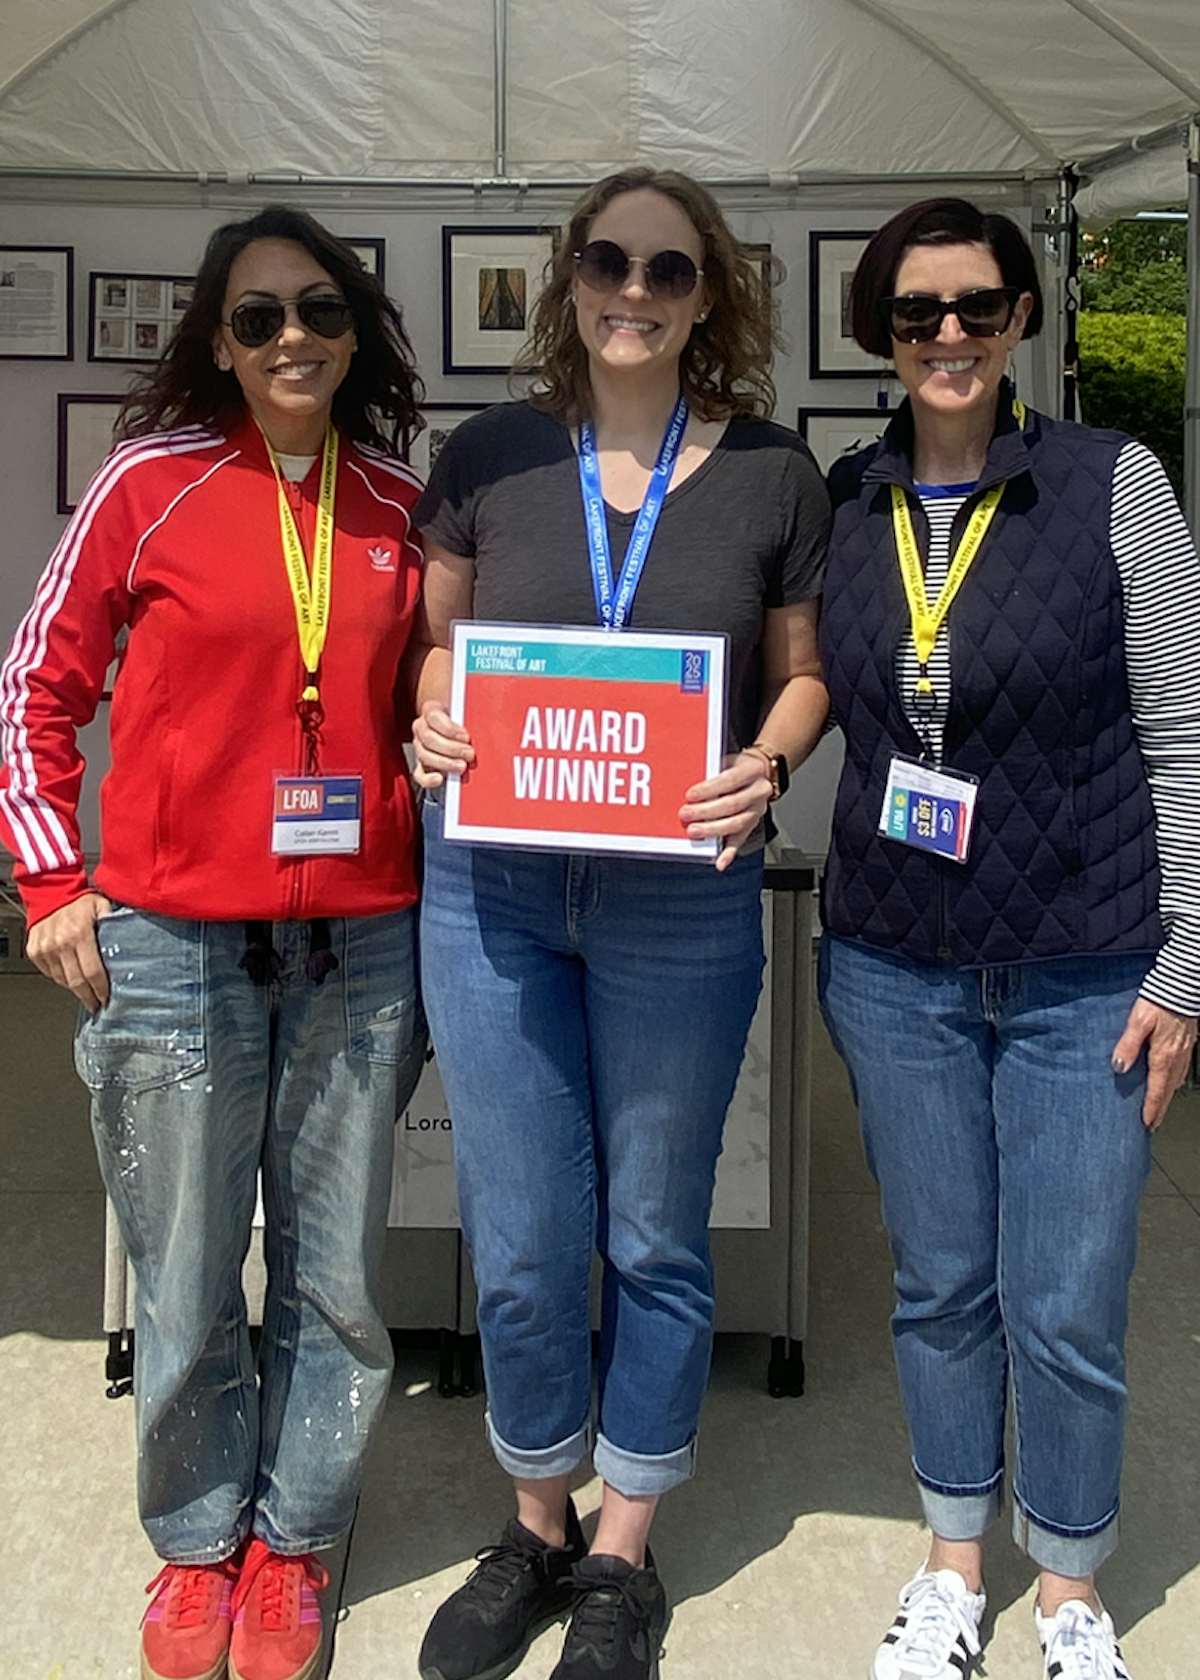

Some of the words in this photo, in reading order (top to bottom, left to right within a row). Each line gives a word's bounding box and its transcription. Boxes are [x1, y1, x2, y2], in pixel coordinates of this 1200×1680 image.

[659, 422, 682, 477] LAKEFRONT
[583, 455, 594, 474] ART
[644, 499, 657, 518] ART
[320, 527, 328, 540] OF
[590, 498, 605, 552] LAKEFRONT
[639, 519, 650, 533] OF
[319, 543, 328, 577] FESTIVAL
[625, 536, 646, 579] FESTIVAL
[904, 547, 918, 585] FESTIVAL
[291, 553, 304, 592] FESTIVAL
[597, 555, 611, 603] FESTIVAL
[932, 574, 959, 623] LAKEFRONT
[955, 536, 977, 573] FESTIVAL
[973, 521, 983, 535] OF
[299, 592, 308, 605] OF
[316, 578, 327, 627] LAKEFRONT
[912, 585, 922, 602] OF
[302, 607, 311, 625] ART
[602, 604, 612, 619] OF
[915, 601, 925, 617] ART
[471, 644, 523, 658] LAKEFRONT
[475, 656, 514, 670] FESTIVAL
[516, 658, 528, 671] OF
[528, 659, 546, 673] ART
[520, 706, 646, 754] AWARD
[513, 755, 652, 806] WINNER
[283, 789, 318, 809] LFOA
[919, 798, 931, 820] OFF
